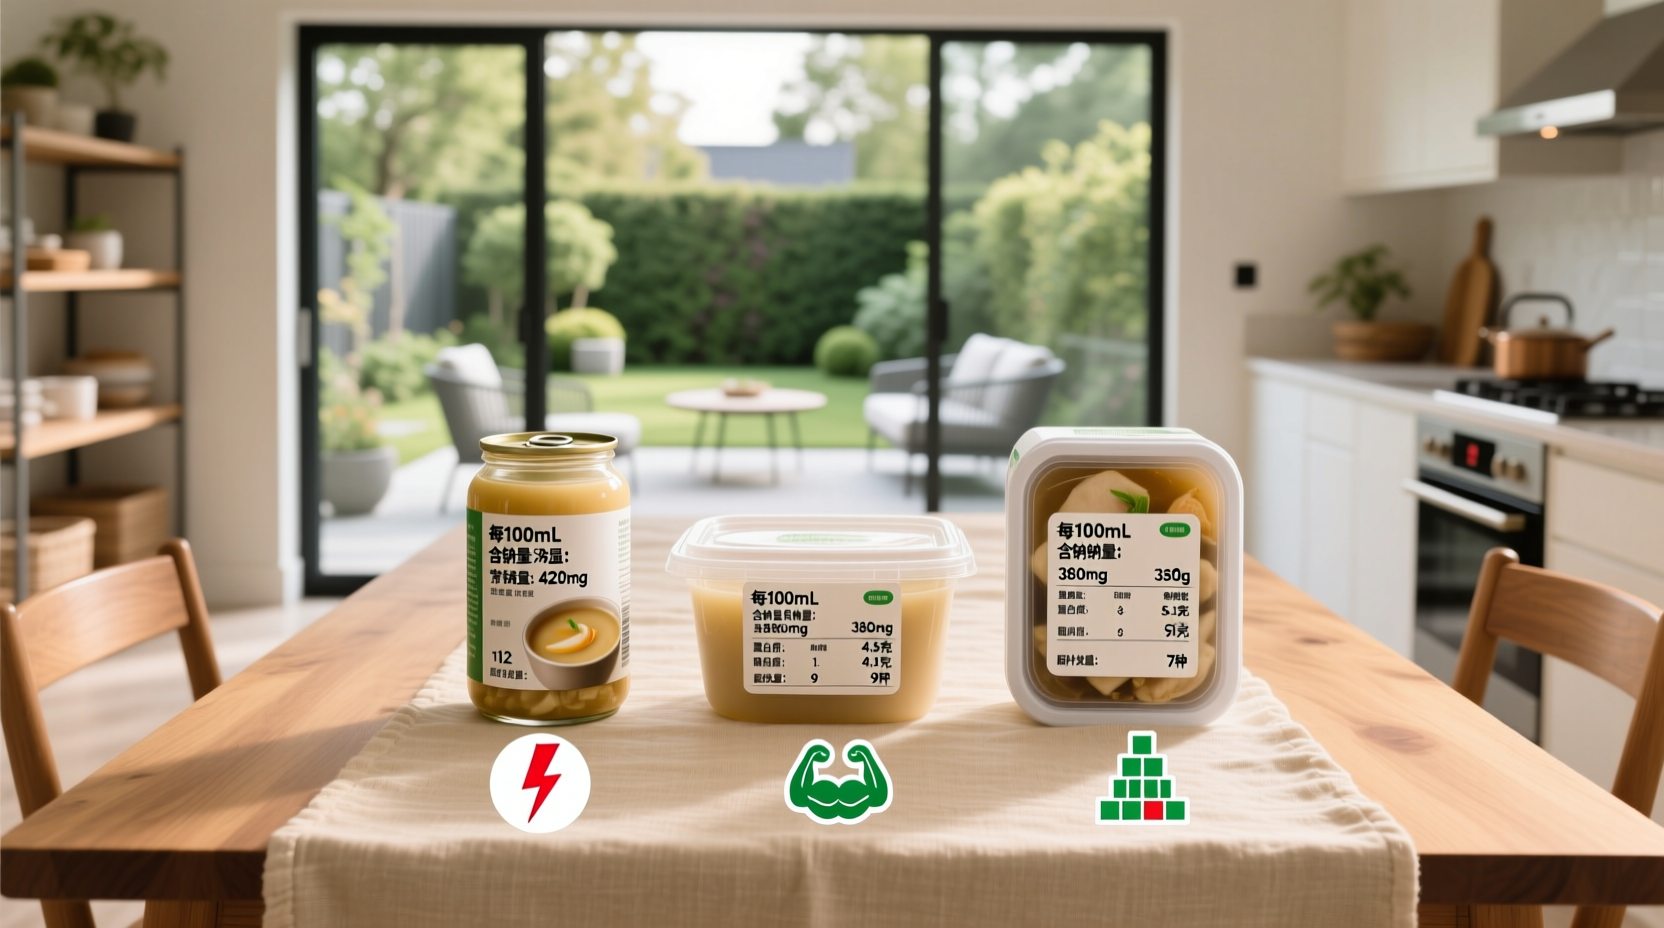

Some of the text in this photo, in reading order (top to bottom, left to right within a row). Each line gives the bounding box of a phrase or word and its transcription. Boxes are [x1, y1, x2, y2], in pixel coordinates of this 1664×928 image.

[489, 524, 562, 543] 每100mL
[1056, 521, 1132, 540] 每100mL
[538, 570, 588, 588] 420mg
[1057, 567, 1108, 585] 380mg
[750, 589, 819, 606] 每100mL
[810, 673, 819, 684] 9
